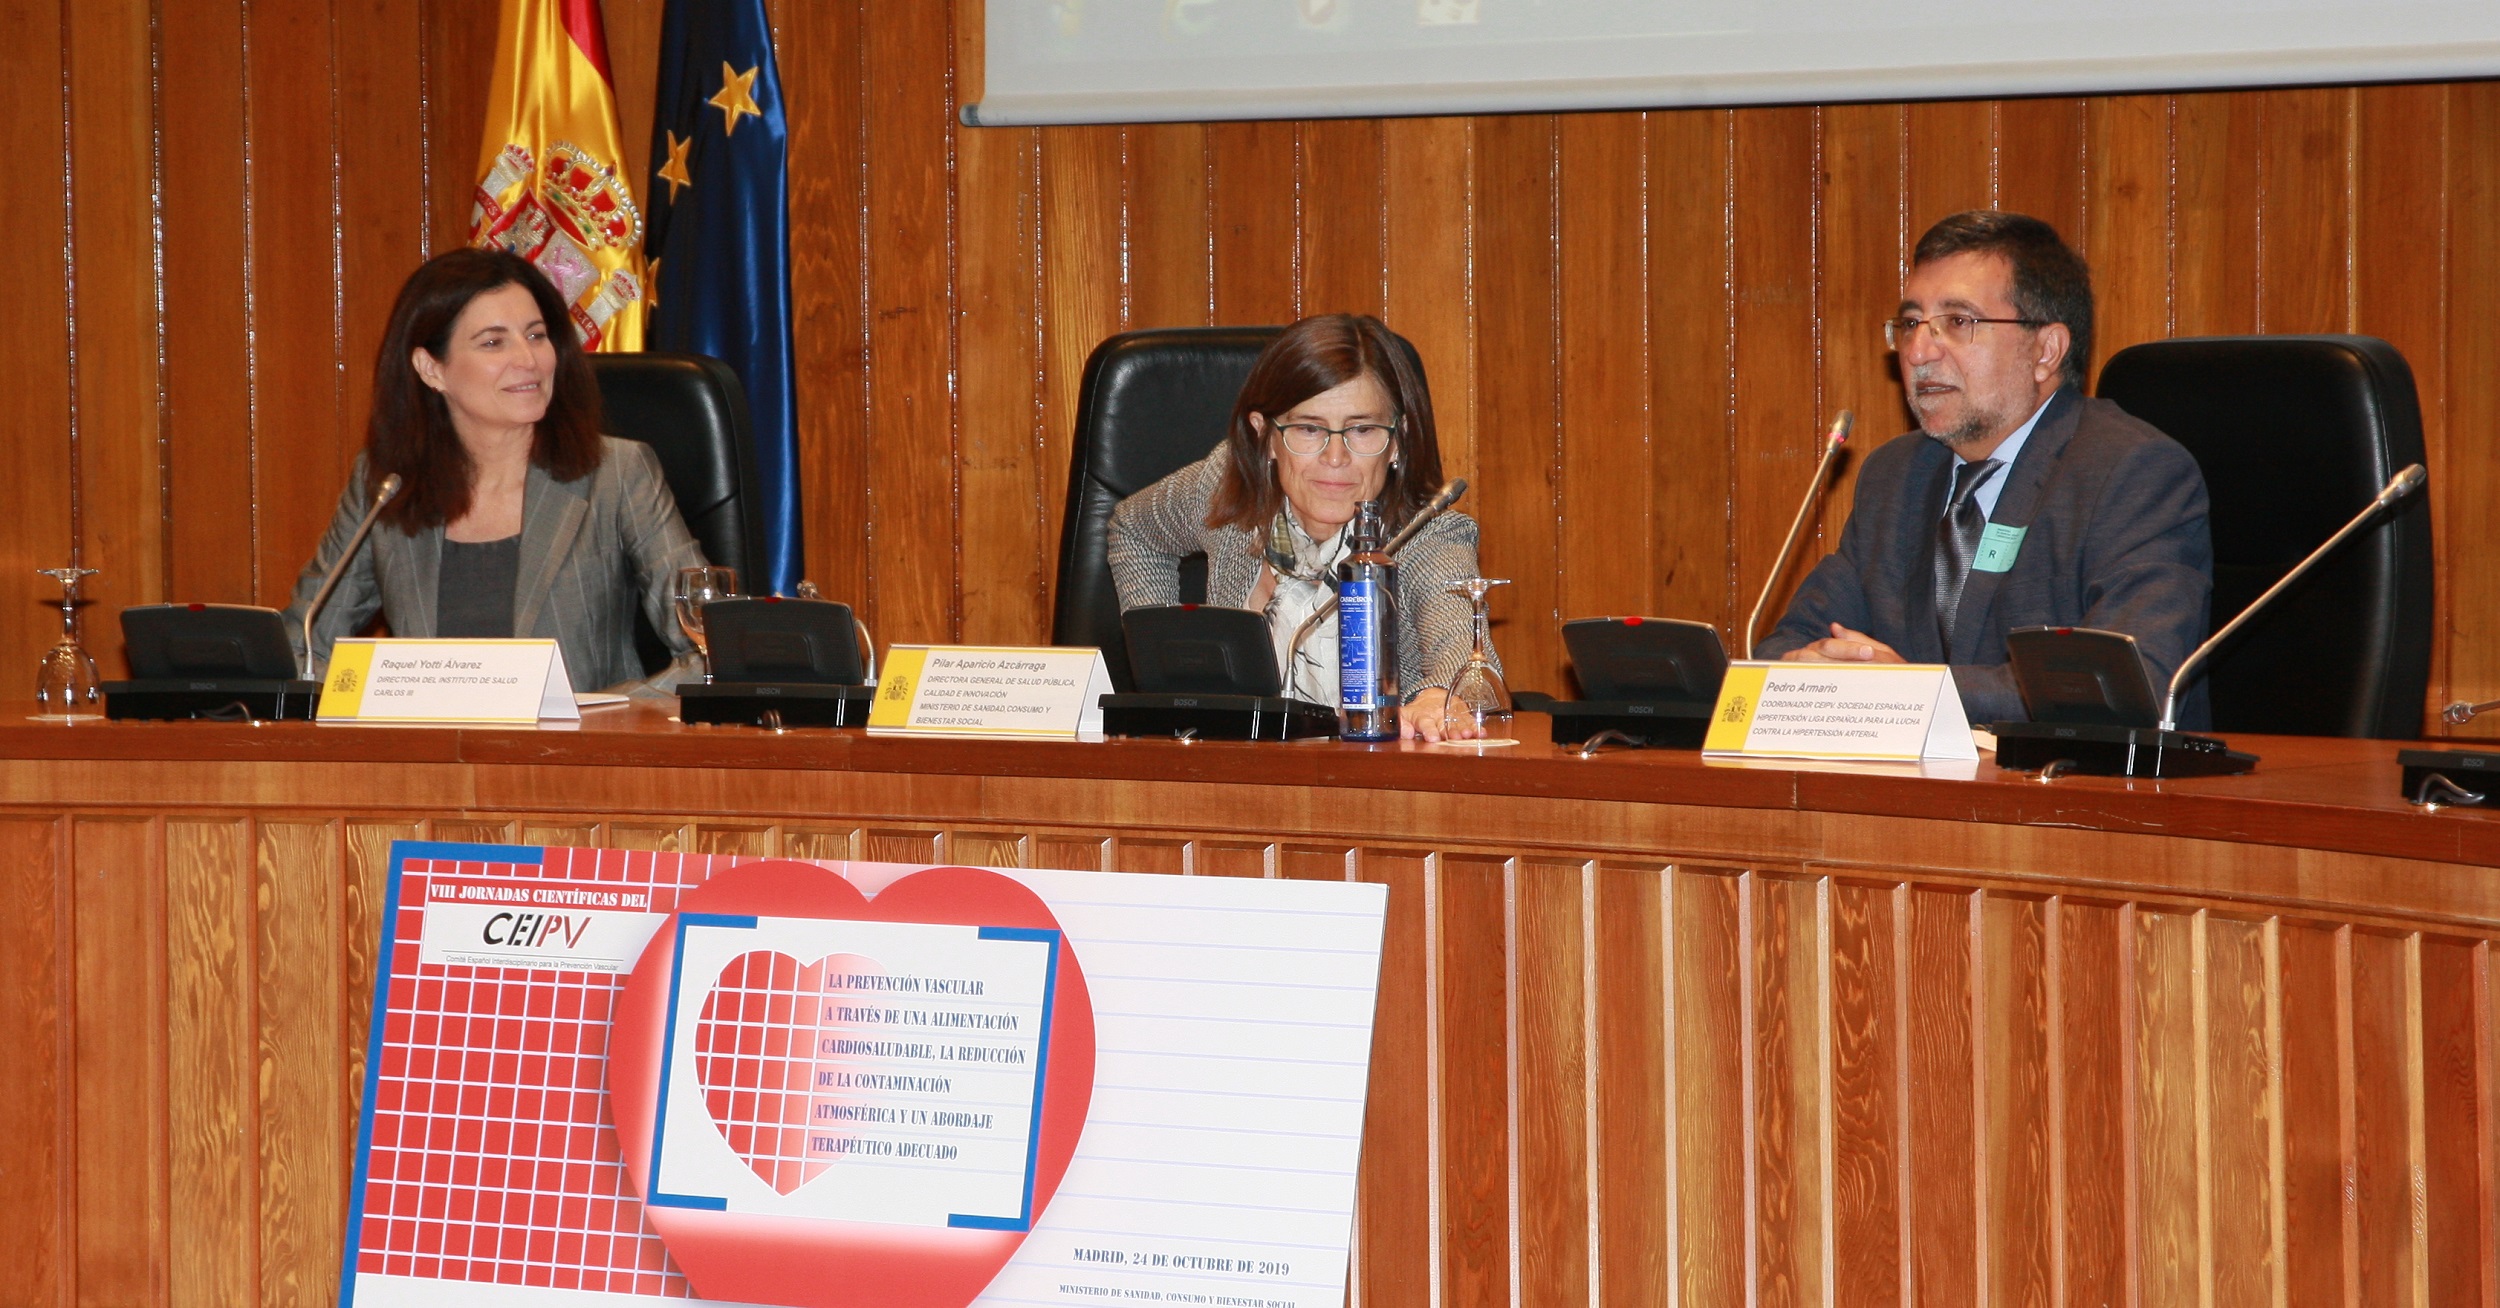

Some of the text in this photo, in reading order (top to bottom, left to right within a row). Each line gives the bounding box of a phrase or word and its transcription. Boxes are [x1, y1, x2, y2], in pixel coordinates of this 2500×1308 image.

[1989, 549, 1996, 559] R
[381, 658, 483, 671] Raquel Yotti Álvarez
[932, 659, 1046, 672] Pilar Aparicio Azcárraga
[376, 676, 420, 684] DIRECTORA
[1043, 677, 1075, 687] PÚBLICA,
[756, 687, 780, 695] BOSCH
[962, 689, 1007, 698] INNOVACIÓN
[1766, 682, 1838, 693] Pedro Armario
[1629, 706, 1654, 714] BOSCH
[1761, 700, 1813, 709] COORDINADOR
[1837, 702, 1874, 710] SOCIEDAD
[1875, 702, 1912, 711] ESPAÑOLA
[1757, 713, 1807, 722] HIPERTENSIÓN
[1826, 715, 1863, 723] ESPAÑOLA
[1864, 716, 1884, 724] PARA
[1896, 717, 1920, 725] LUCHA
[1782, 728, 1792, 736] LA
[1844, 730, 1879, 738] ARTERIAL
[2463, 758, 2485, 767] BOSCH
[431, 884, 647, 908] VIII JORNADAS CIENTÍFICAS DEL
[483, 912, 592, 948] CEIPV
[467, 956, 490, 964] Español
[492, 957, 538, 967] Interdisciplinario
[561, 961, 592, 969] Prevención
[594, 963, 619, 971] Vascular
[829, 974, 984, 995] LA PREVENCIÓN VASCULAR
[825, 1005, 1019, 1030] A TRAVÉS DE UNA ALIMENTACIÓN
[822, 1039, 1026, 1064] CARDIOSALUDABLE, LA REDUCCIÓN
[818, 1071, 952, 1093] DE LA CONTAMINACIÓN
[815, 1104, 993, 1129] ATMOSFÉRICA Y UN ABORDAJE
[812, 1136, 957, 1160] TERAPÉUTICO ADECUADO
[1073, 1248, 1290, 1276] MADRID, 24 DE OCTUBRE DE 2019
[1059, 1284, 1109, 1296] MINISTERIO
[1111, 1288, 1122, 1297] DE
[1124, 1289, 1164, 1302] SANIDAD,
[1166, 1292, 1206, 1304] CONSUMO
[1209, 1295, 1214, 1304] Y
[1217, 1296, 1264, 1308] BIENESTAR
